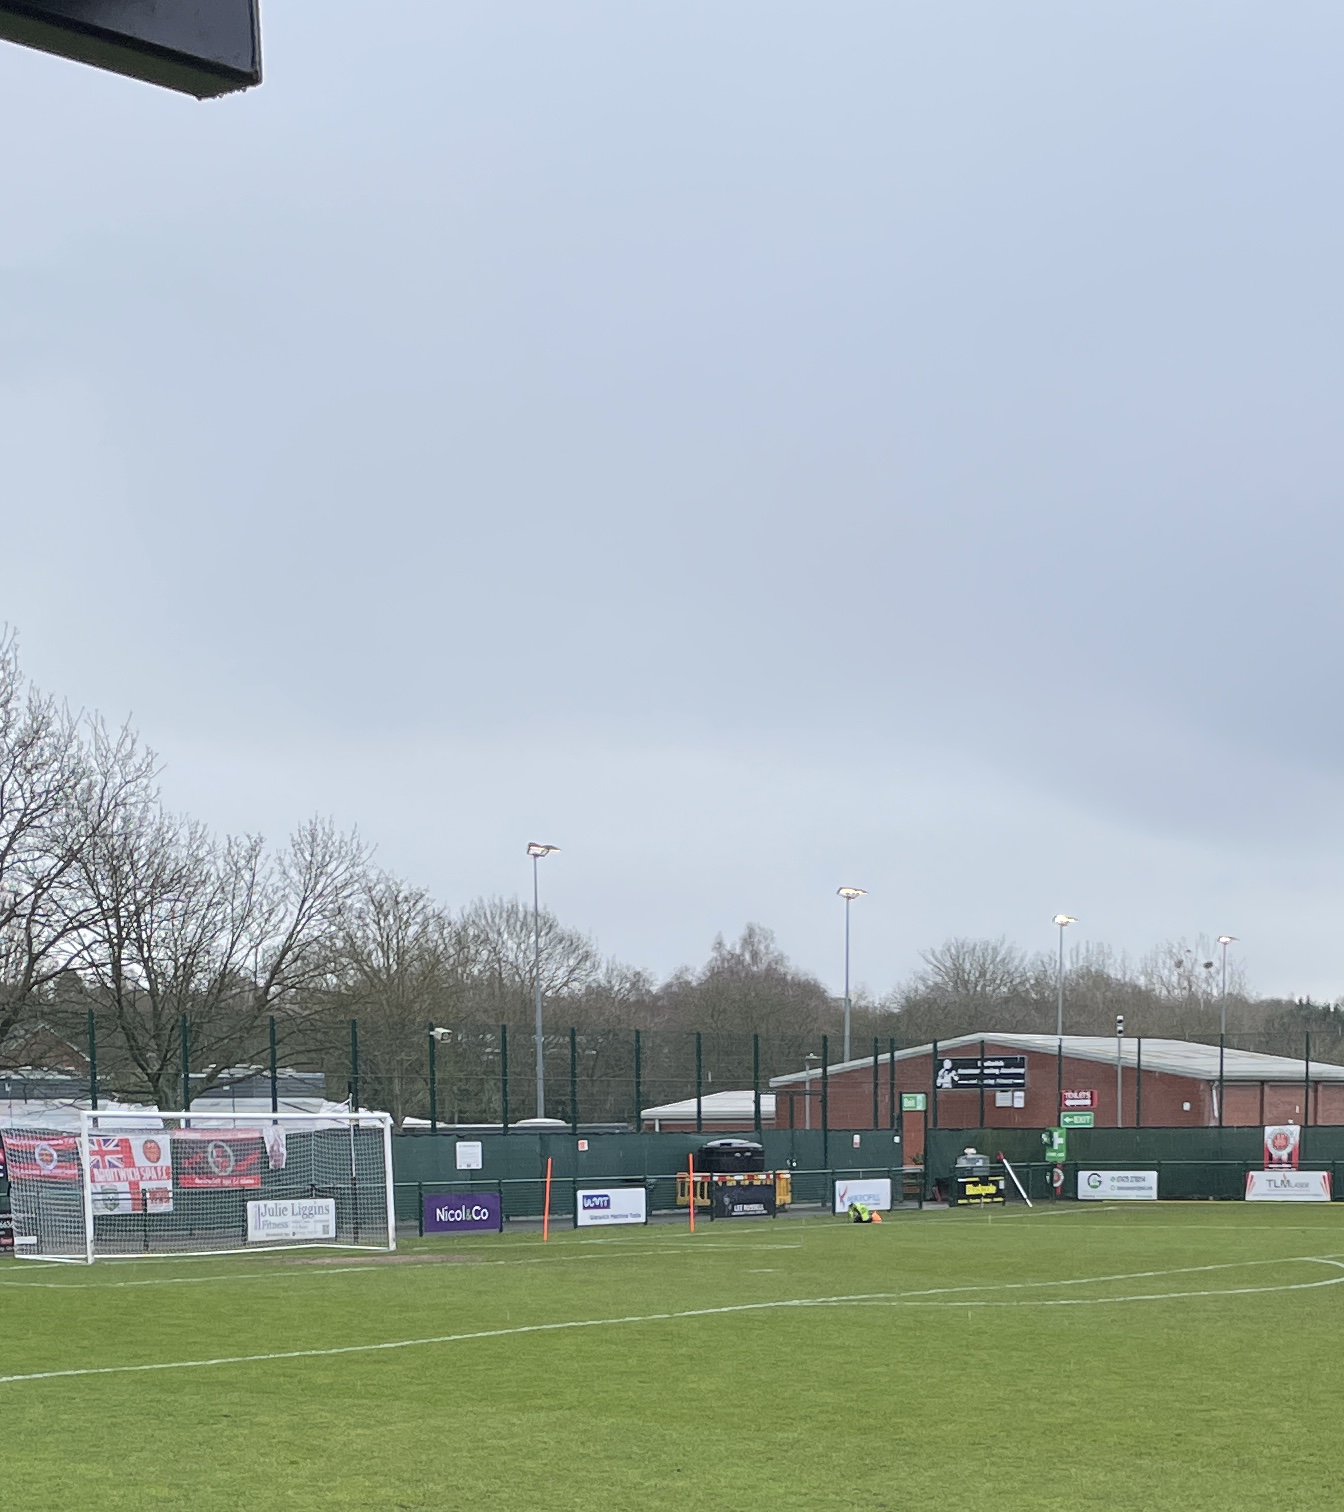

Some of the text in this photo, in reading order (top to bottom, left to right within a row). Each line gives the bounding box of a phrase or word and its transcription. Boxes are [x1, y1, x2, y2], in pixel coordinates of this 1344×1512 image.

[261, 1202, 330, 1219] Julie Liggins
[262, 1220, 289, 1230] Fitness
